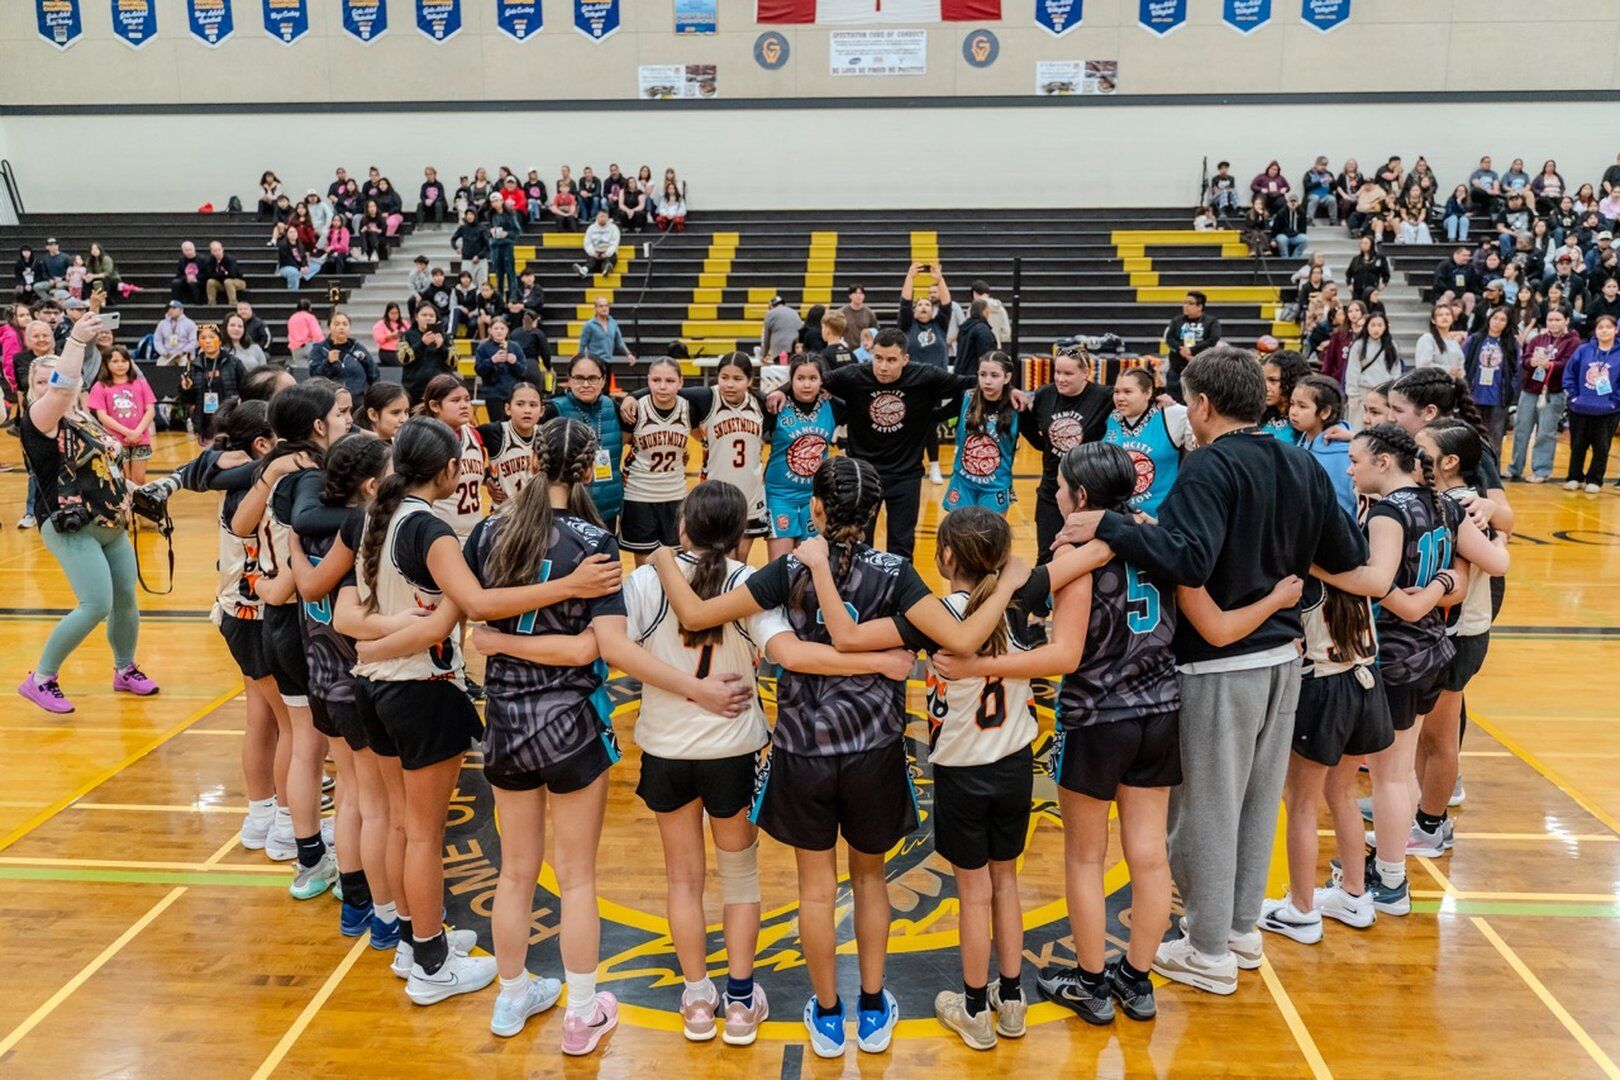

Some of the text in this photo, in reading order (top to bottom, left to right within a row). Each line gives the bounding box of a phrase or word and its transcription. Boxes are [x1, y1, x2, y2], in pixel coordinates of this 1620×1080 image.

[788, 425, 830, 440] VANCITY
[870, 421, 905, 434] NATION
[732, 438, 746, 468] 3
[1122, 440, 1153, 455] NCITY
[650, 451, 677, 473] 22
[958, 467, 997, 485] NATION
[455, 480, 482, 516] 29
[996, 490, 1006, 506] 8
[1416, 525, 1452, 588] 10
[1124, 560, 1161, 635] 5
